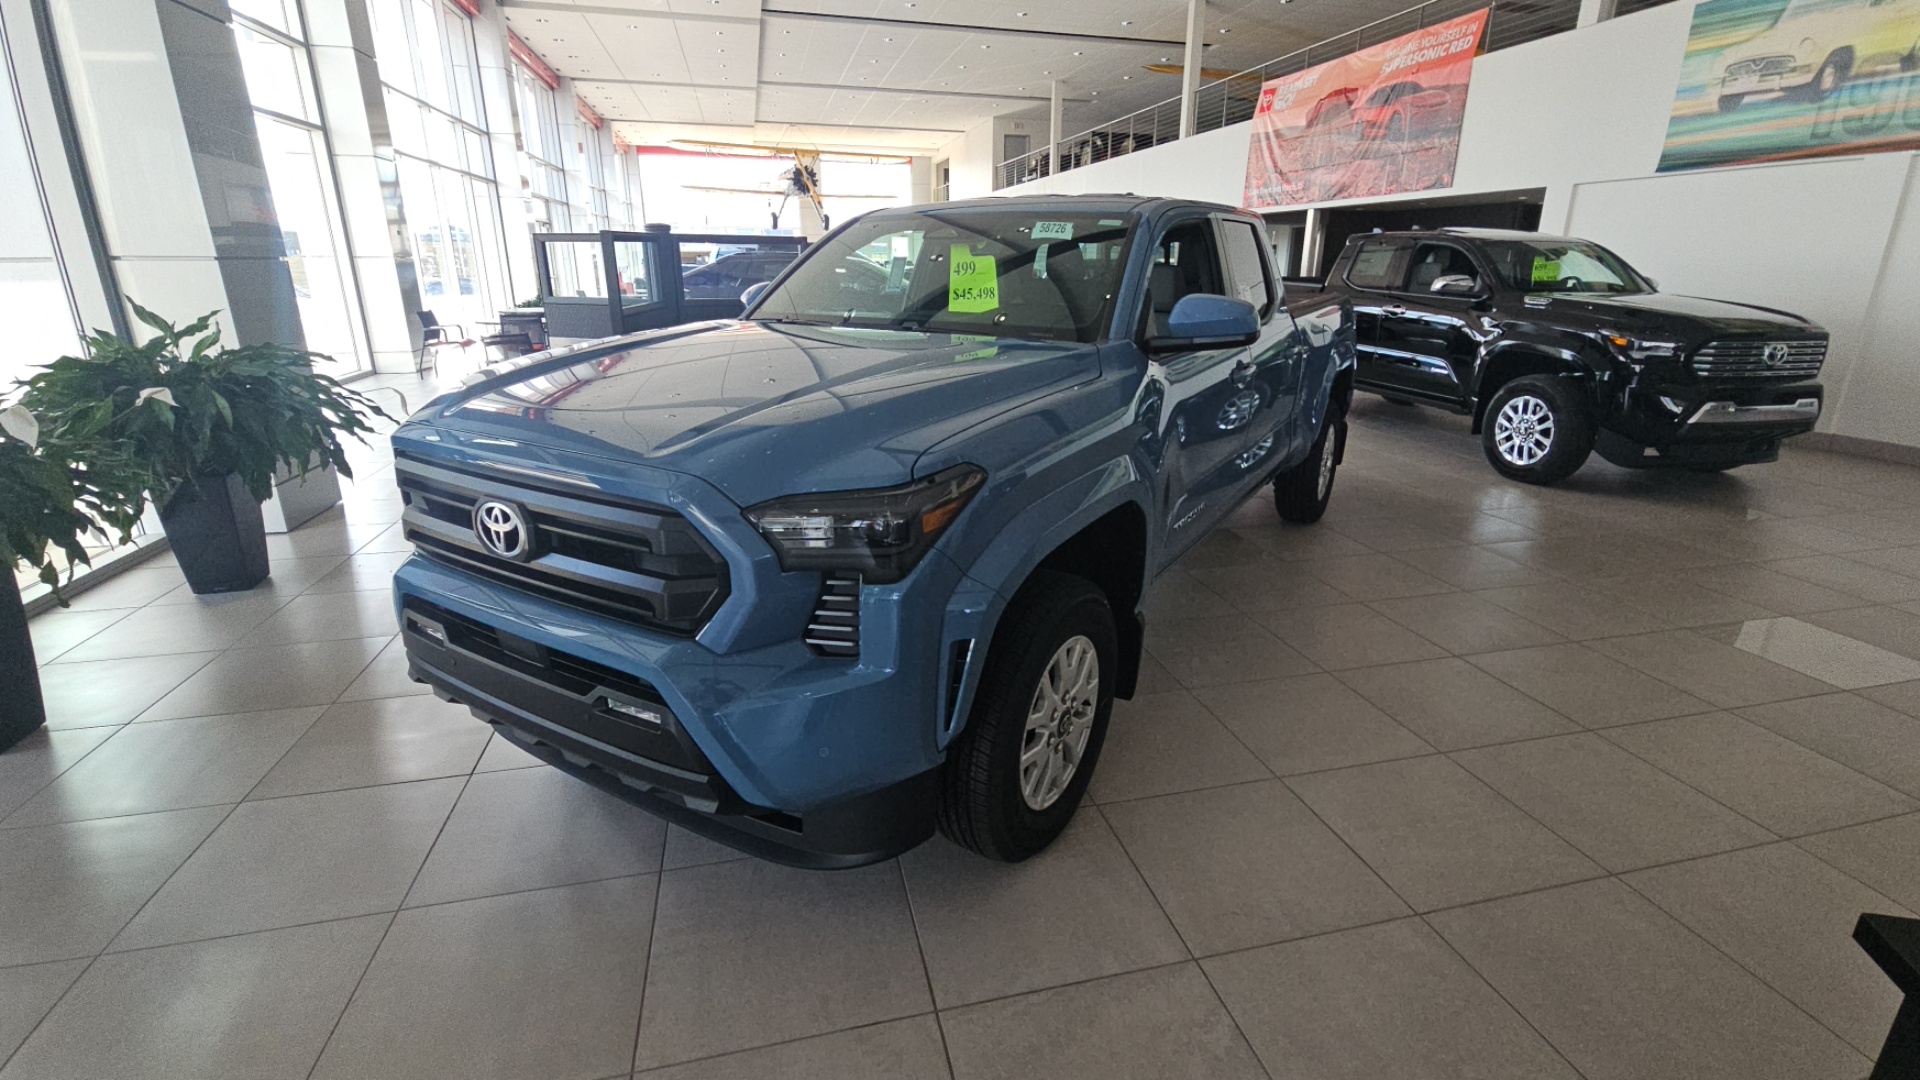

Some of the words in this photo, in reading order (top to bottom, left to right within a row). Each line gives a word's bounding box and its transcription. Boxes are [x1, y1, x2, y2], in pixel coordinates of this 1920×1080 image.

[1421, 28, 1467, 49] YOURSELF
[1467, 21, 1479, 35] IN
[1381, 43, 1450, 75] SUPERSONIC
[1448, 35, 1475, 56] RED
[1039, 222, 1068, 234] 58726
[953, 261, 976, 276] 499
[952, 287, 995, 301] $45,498
